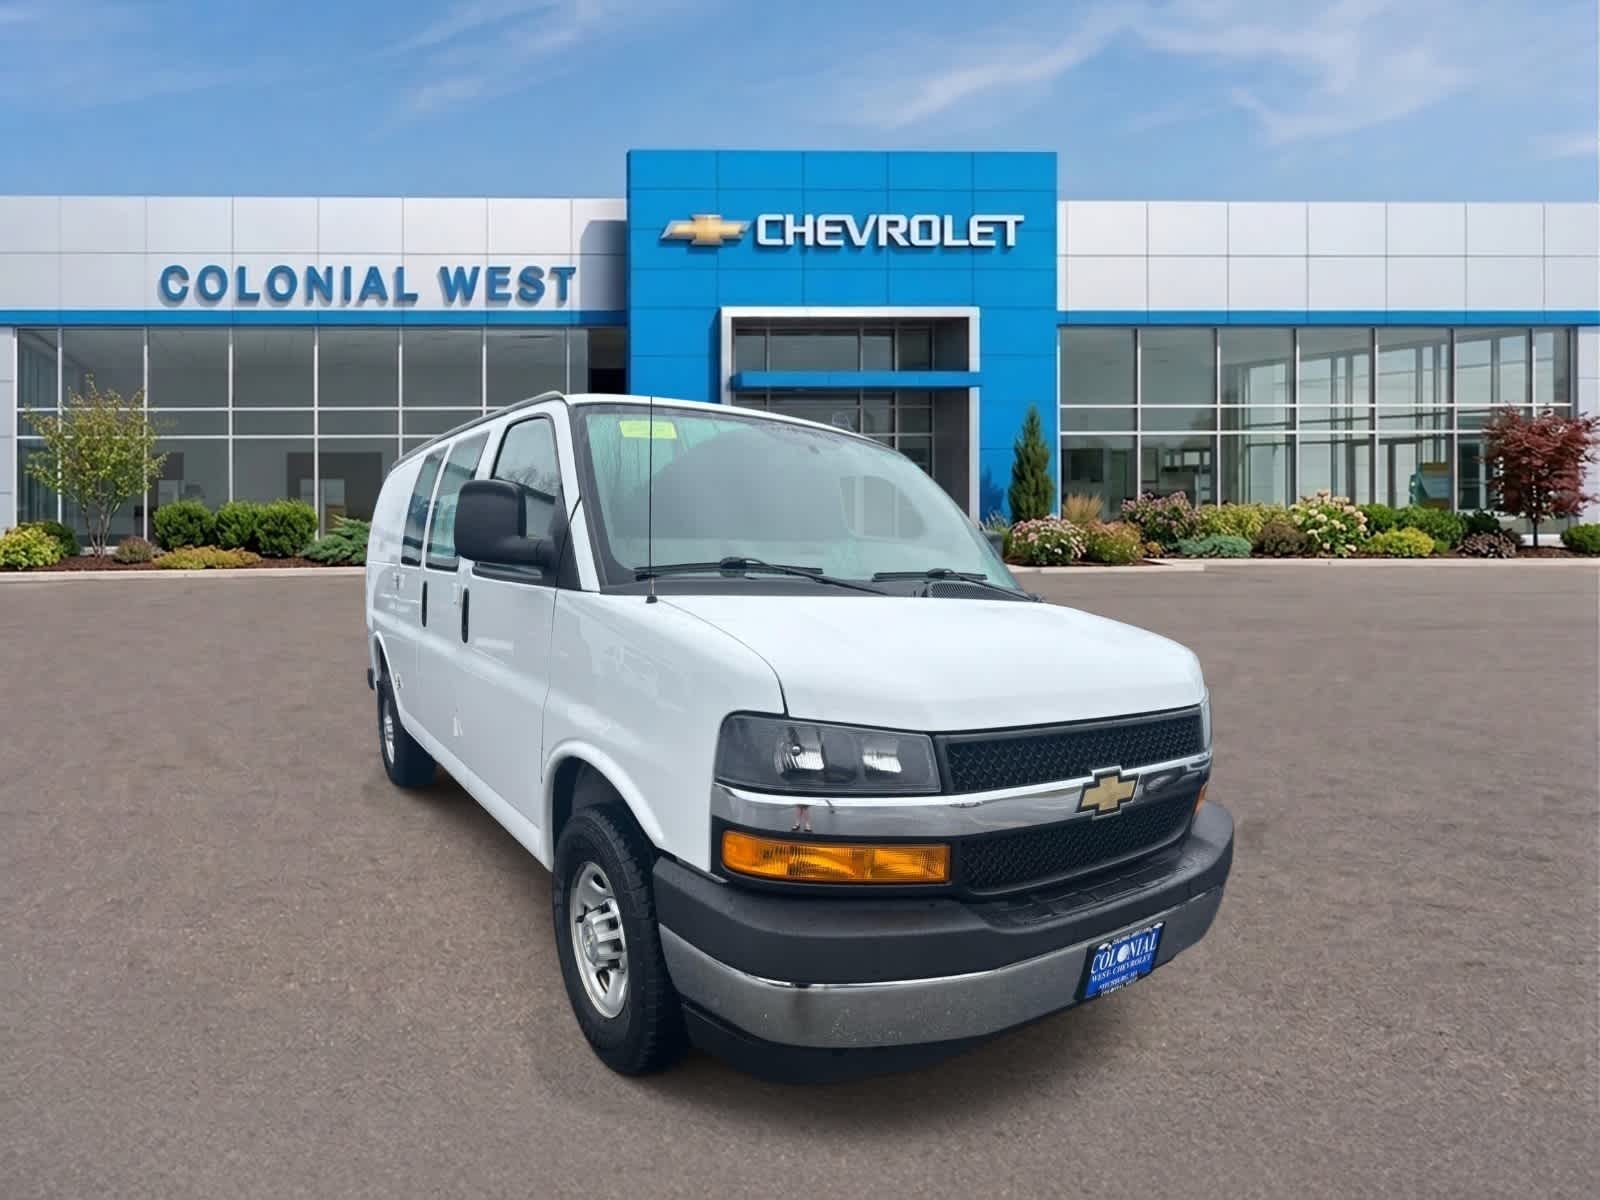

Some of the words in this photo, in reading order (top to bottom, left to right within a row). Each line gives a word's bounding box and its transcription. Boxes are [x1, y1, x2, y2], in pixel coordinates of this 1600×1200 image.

[757, 214, 1024, 247] CHEVROLET
[161, 265, 418, 302] COLONIAL
[439, 265, 576, 302] WEST
[1090, 933, 1156, 974] COLONIAL
